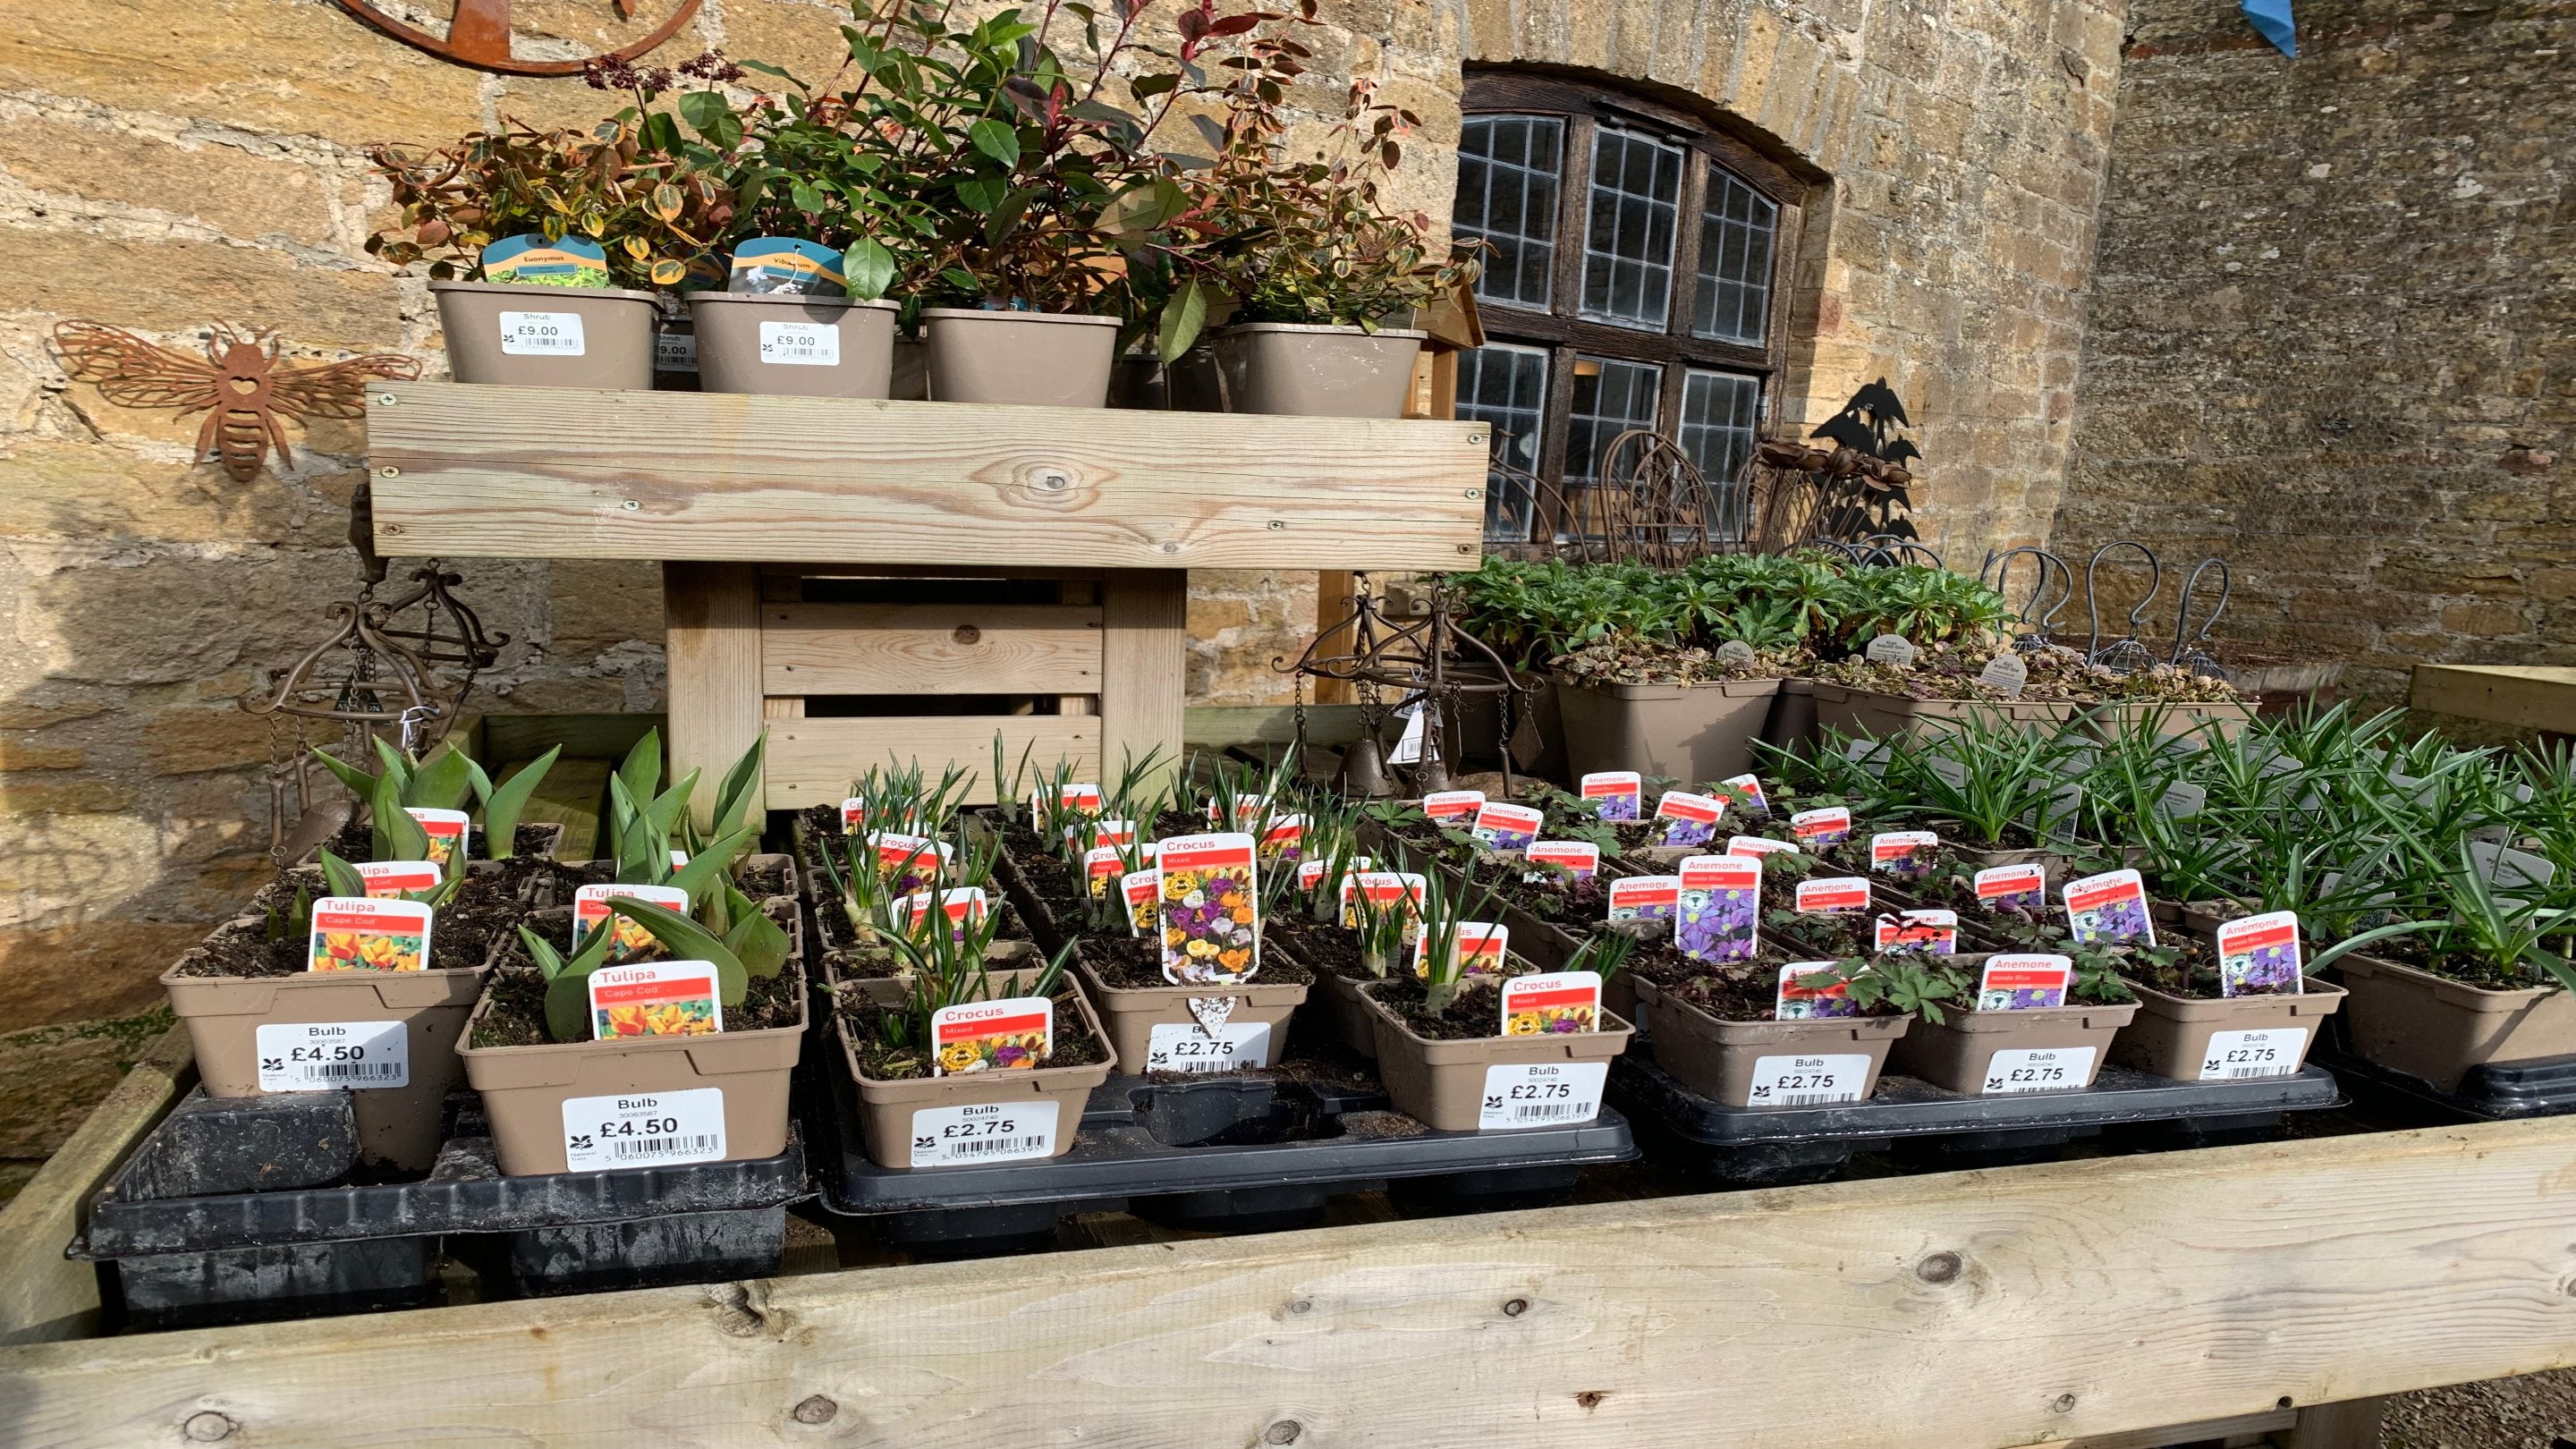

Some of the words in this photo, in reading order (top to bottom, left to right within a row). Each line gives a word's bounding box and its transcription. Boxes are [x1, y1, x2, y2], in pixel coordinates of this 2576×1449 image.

[774, 258, 810, 268] Vibuum
[518, 326, 558, 335] £9.00
[777, 335, 815, 346] £9.00
[660, 345, 686, 354] 9.00
[1430, 795, 1471, 803] Anemone
[1669, 794, 1710, 809] Anemone
[1486, 806, 1528, 818] Anemone
[1879, 836, 1922, 844] Anemone
[1166, 841, 1216, 852] Crocus
[1688, 861, 1743, 869] Anemone
[359, 867, 390, 875] lipa
[1982, 869, 2029, 882] Anemone
[1130, 875, 1158, 886] Croc
[1618, 881, 1668, 891] Anemone
[2072, 877, 2123, 894] Anemone
[1803, 884, 1853, 893] Anemone
[325, 900, 376, 913] Tulipa
[2226, 919, 2280, 936] Anemone
[1995, 960, 2052, 969] Anemone
[600, 970, 657, 983] Tulipa
[1513, 980, 1562, 991] Crocus
[945, 1008, 1004, 1021] Crocus
[309, 1027, 346, 1036] Bulb
[945, 1026, 973, 1034] Mixed
[2243, 1033, 2268, 1042] Bulb
[291, 1046, 365, 1062] £4.50
[1175, 1042, 1233, 1055] £2.75
[2029, 1053, 2055, 1061] Bulb
[2226, 1048, 2275, 1063] £2.75
[1795, 1059, 1824, 1067] Bulb
[1529, 1066, 1559, 1075] Bulb
[2010, 1068, 2063, 1081] £2.75
[1777, 1075, 1835, 1089] £2.75
[1511, 1084, 1570, 1099] £2.75
[618, 1097, 657, 1109] Bulb
[963, 1106, 999, 1115] Bulb
[600, 1117, 678, 1138] £4.50
[944, 1120, 1014, 1139] £2.75
[620, 1152, 664, 1161] 060075
[671, 1148, 714, 1157] 966323
